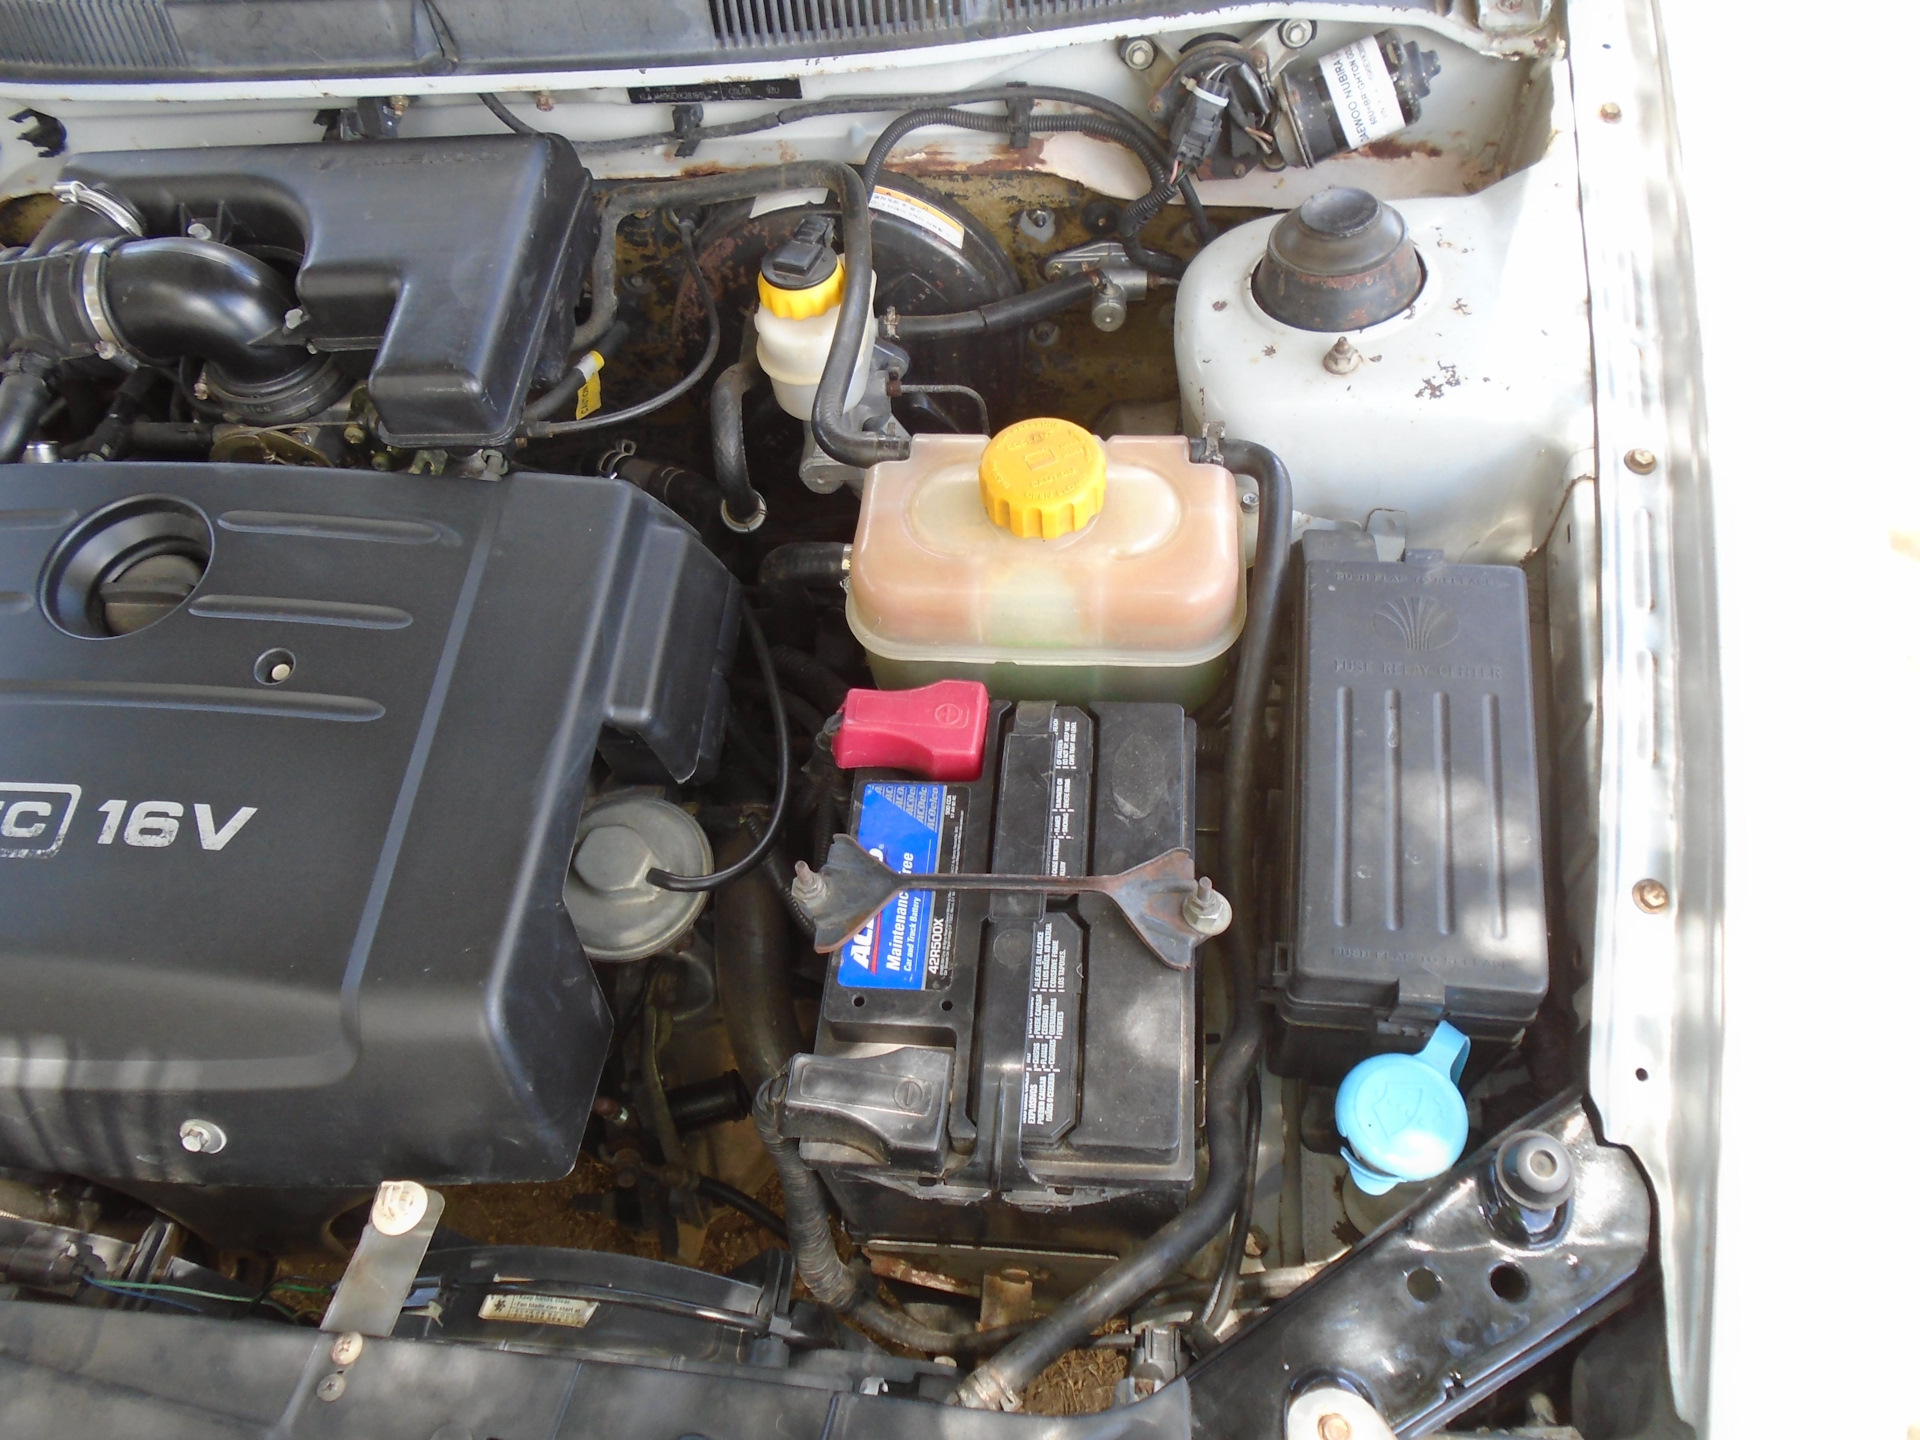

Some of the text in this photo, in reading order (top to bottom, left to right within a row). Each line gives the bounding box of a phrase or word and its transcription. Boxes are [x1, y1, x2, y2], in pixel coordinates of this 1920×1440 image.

[1333, 60, 1353, 99] NUBIRA
[1348, 101, 1369, 142] DAEWOO
[97, 799, 258, 851] 16V
[926, 787, 938, 831] ACDelco
[886, 852, 914, 971] Maintenanc ree
[903, 897, 921, 971] Car and Truck Battery
[928, 918, 944, 974] 42R500X
[1056, 1011, 1064, 1035] FUERTES
[1028, 1084, 1037, 1124] EXPLOSIVOS
[1038, 1076, 1046, 1100] CAUSAR
